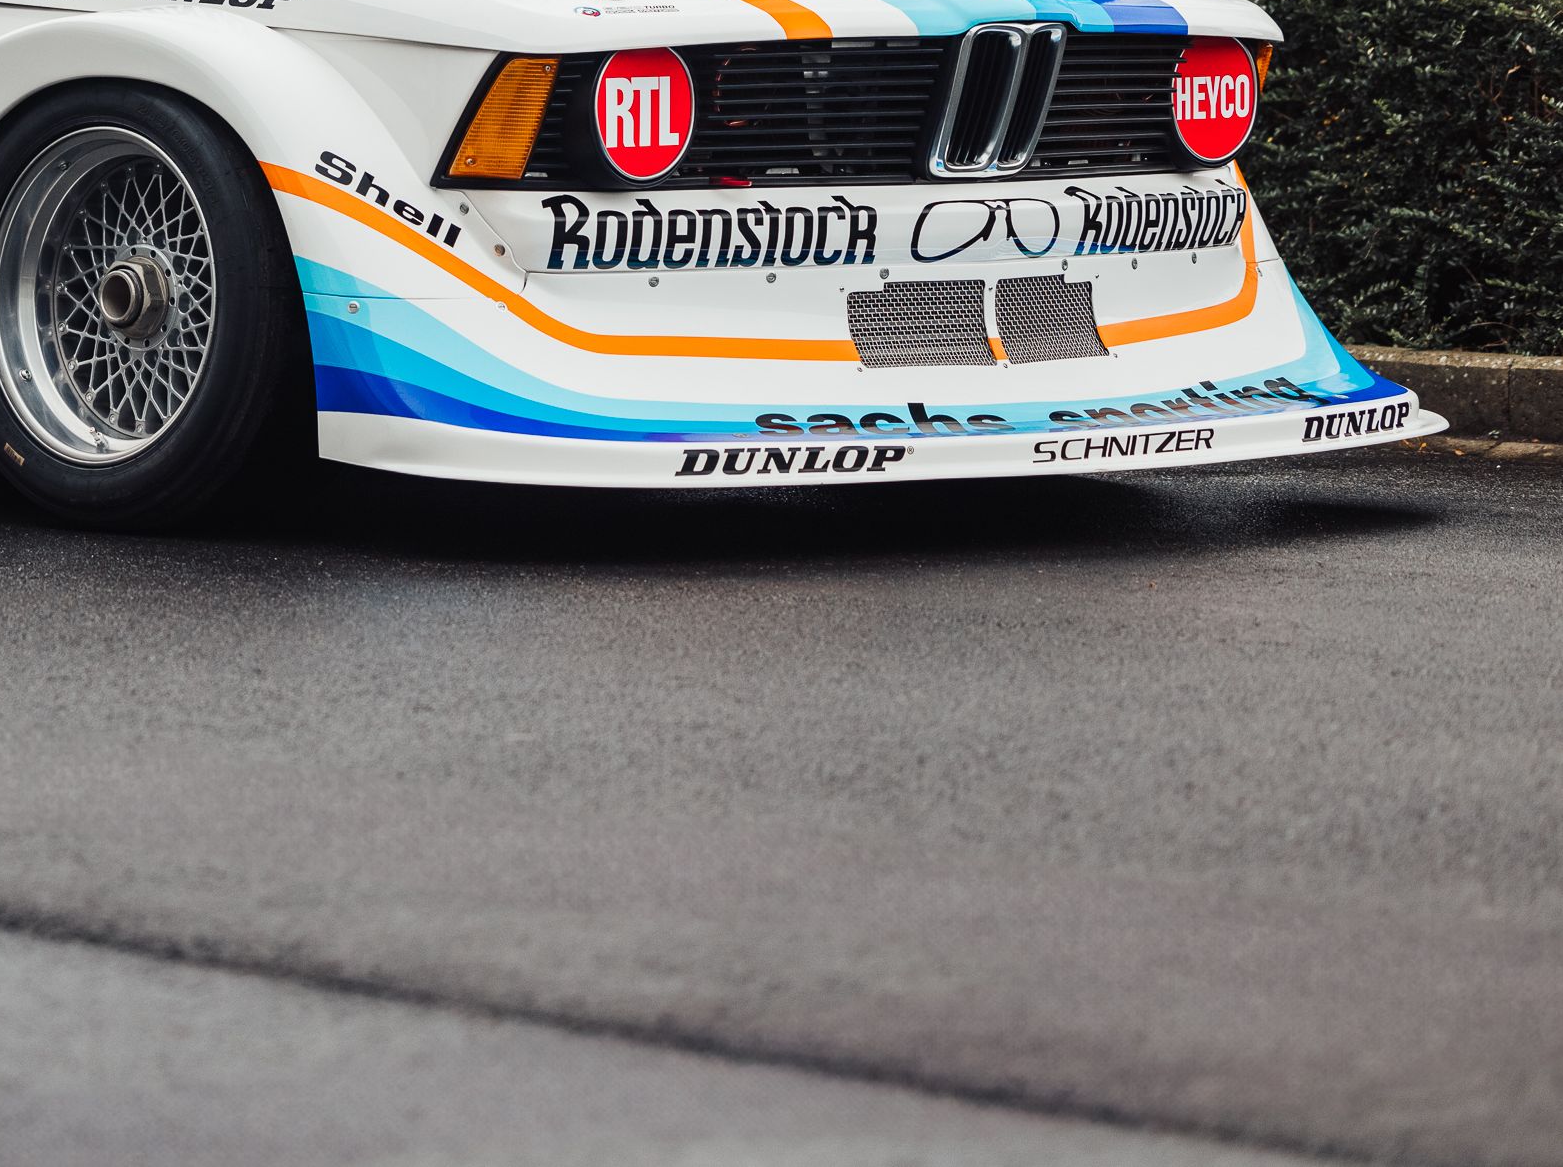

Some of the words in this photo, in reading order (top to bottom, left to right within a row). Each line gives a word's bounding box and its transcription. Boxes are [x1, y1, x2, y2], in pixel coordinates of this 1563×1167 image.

[605, 76, 679, 148] RTL
[1176, 74, 1251, 121] HEYCO
[314, 150, 462, 249] Shell
[541, 194, 878, 271] Rodenstock
[754, 402, 1008, 437] sachs
[1301, 401, 1411, 443] DUNLOP
[1032, 427, 1215, 464] SCHNITZER
